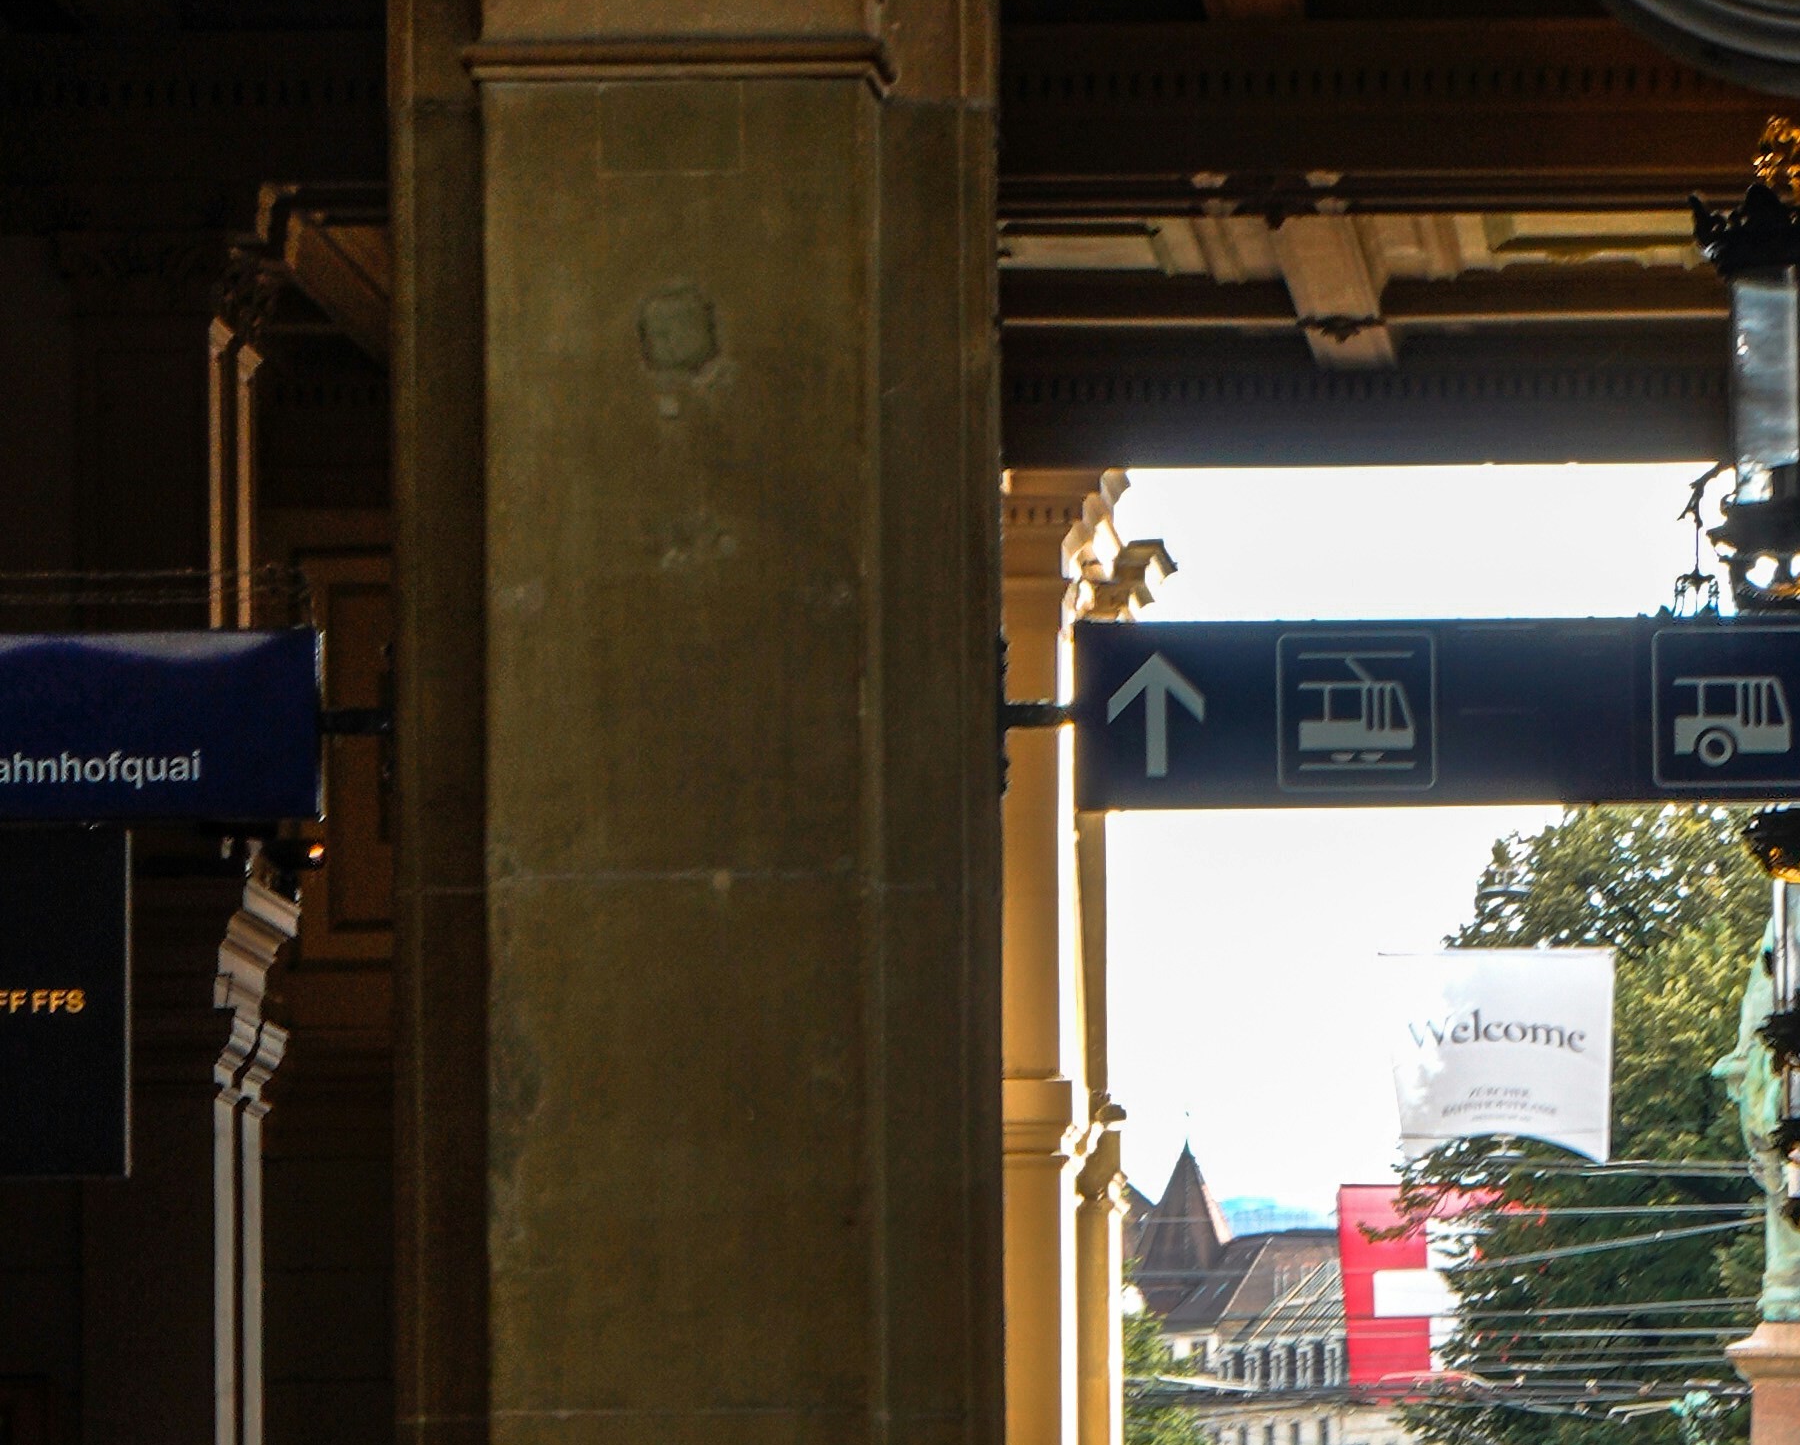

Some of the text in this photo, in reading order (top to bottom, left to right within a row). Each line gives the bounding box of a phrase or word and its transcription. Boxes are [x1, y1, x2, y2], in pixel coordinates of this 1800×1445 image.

[0, 749, 201, 789] ahnhofquai
[0, 988, 27, 1014] FF
[1408, 1008, 1588, 1053] Welcome
